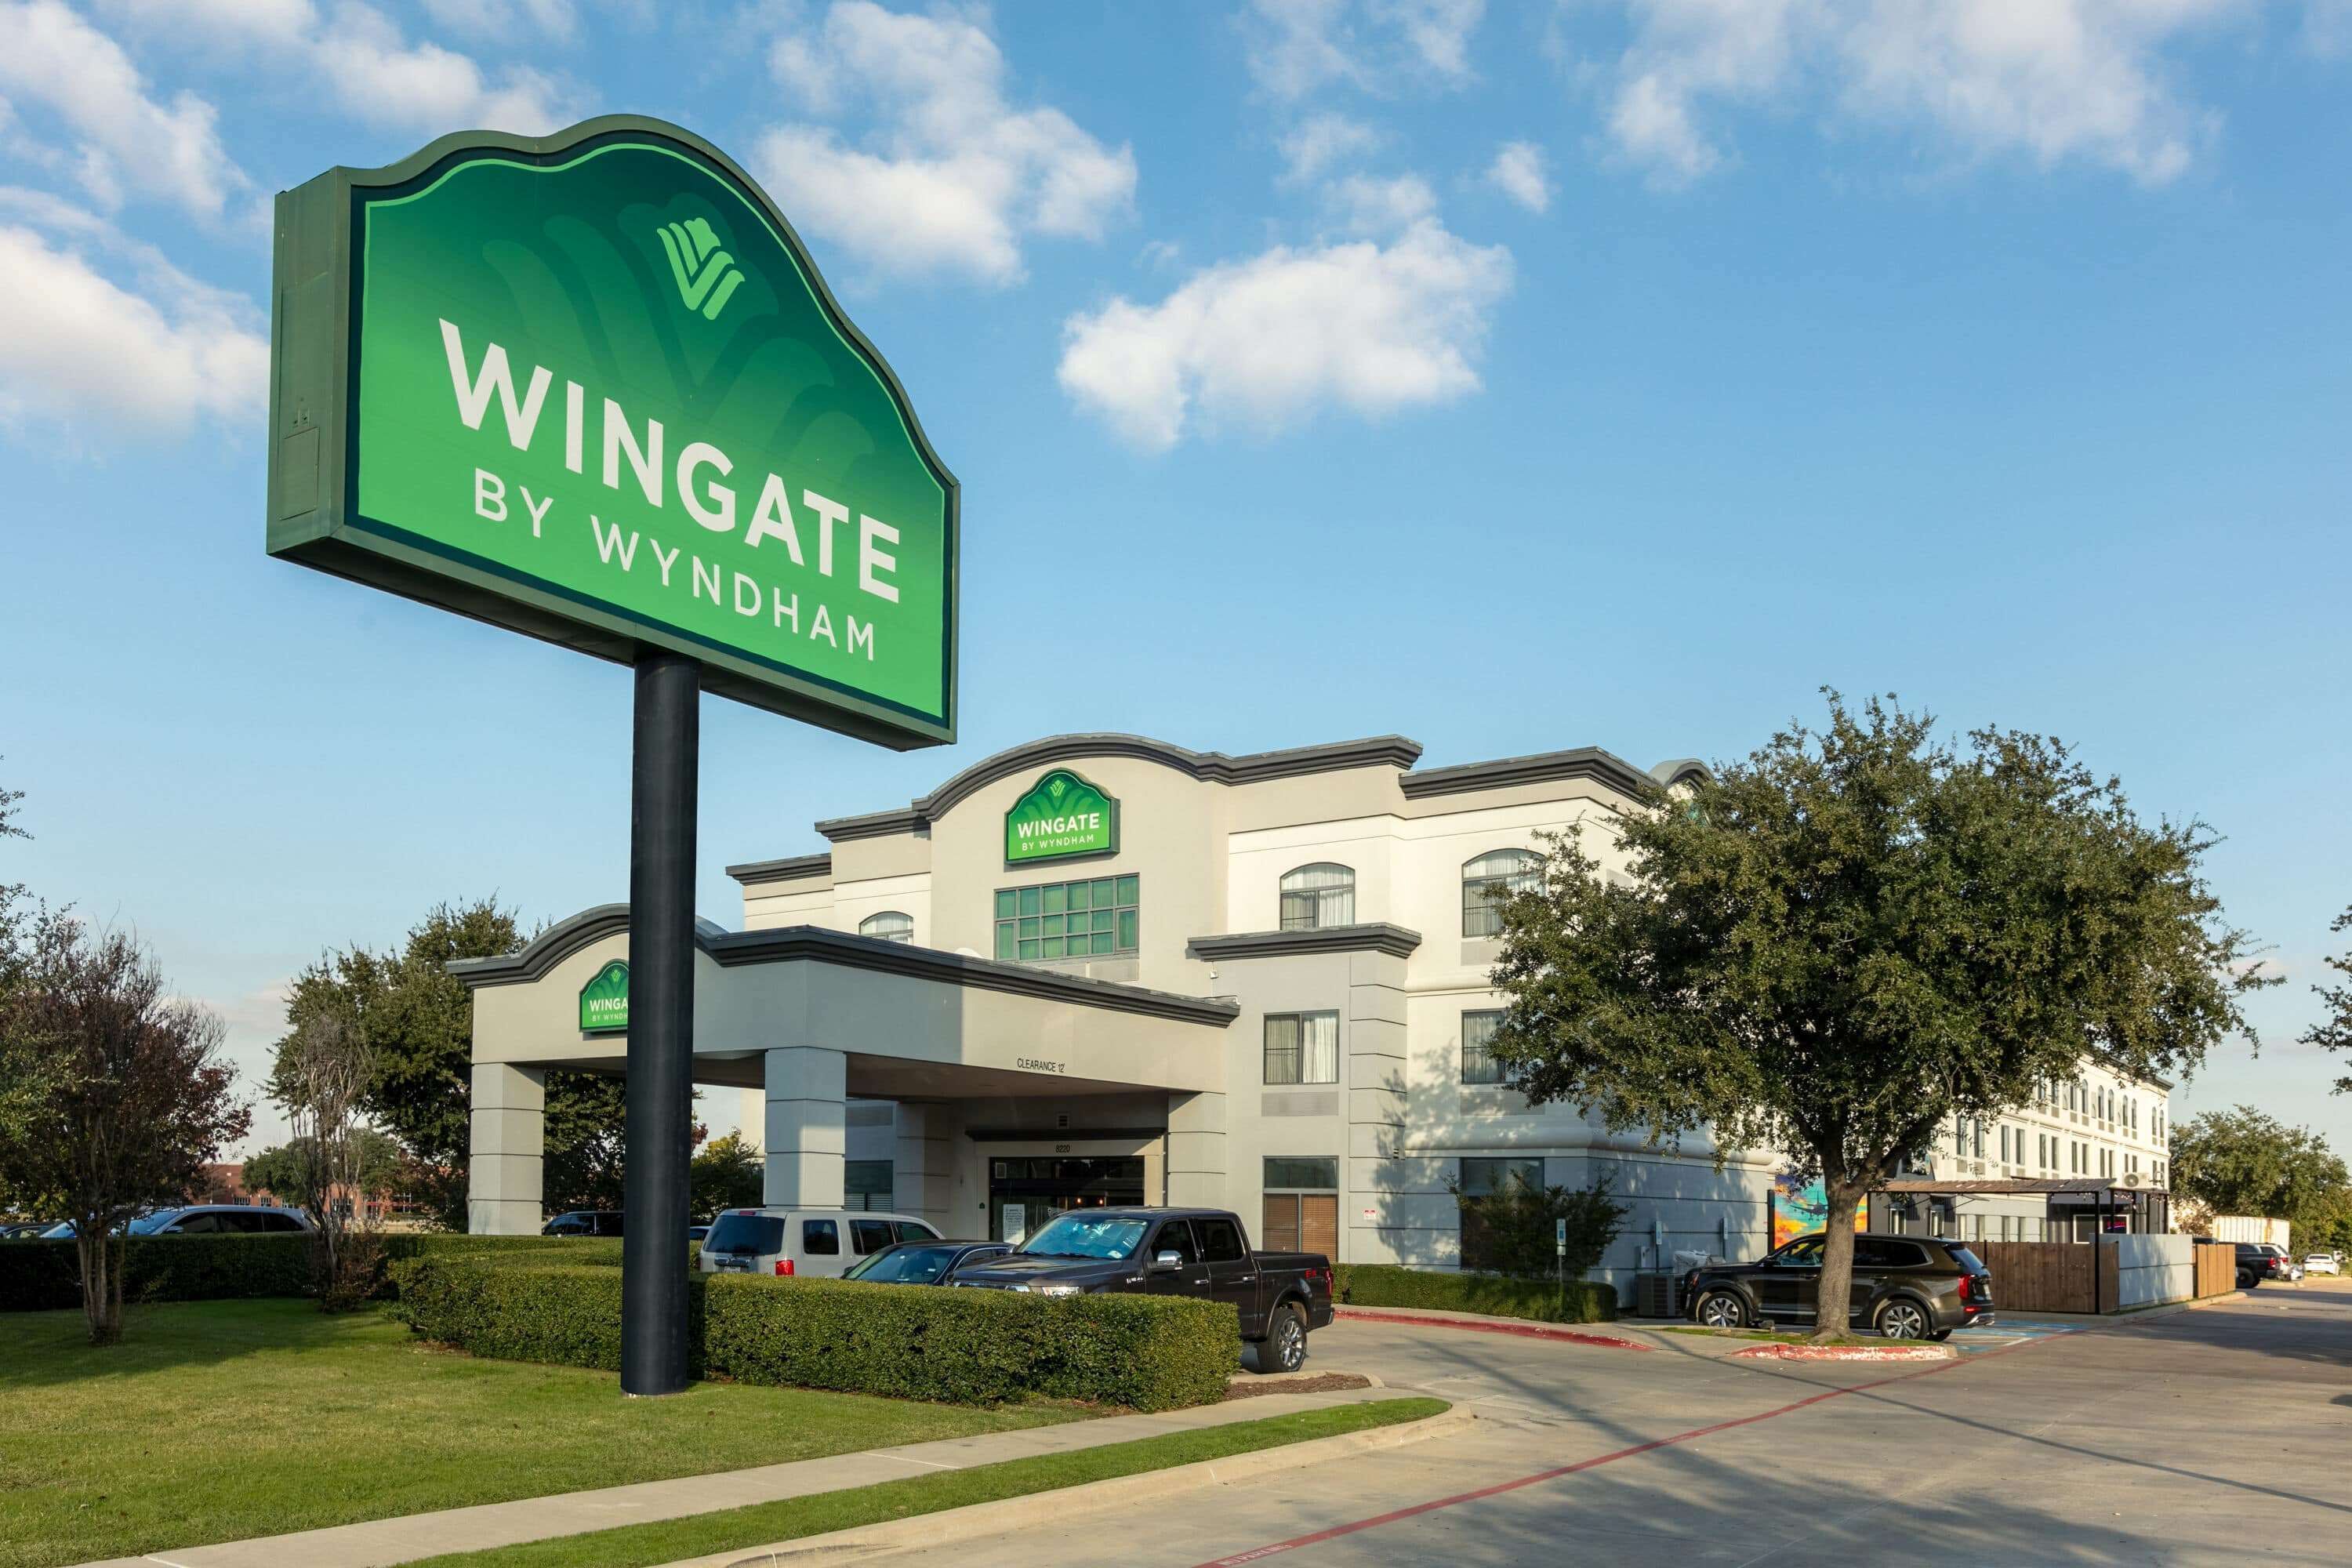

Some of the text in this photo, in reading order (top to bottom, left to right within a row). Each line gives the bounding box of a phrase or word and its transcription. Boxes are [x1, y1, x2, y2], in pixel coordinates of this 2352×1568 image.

[439, 318, 900, 604] WINGATE
[475, 467, 874, 661] BY WYNDHAM
[1017, 812, 1100, 839] WINGATE
[1022, 833, 1095, 851] BY WYNDHAM
[590, 996, 628, 1012] WINGA
[604, 1012, 628, 1021] WYNDH
[1017, 1058, 1056, 1073] CLEARANCE
[1055, 1144, 1071, 1153] 8220
